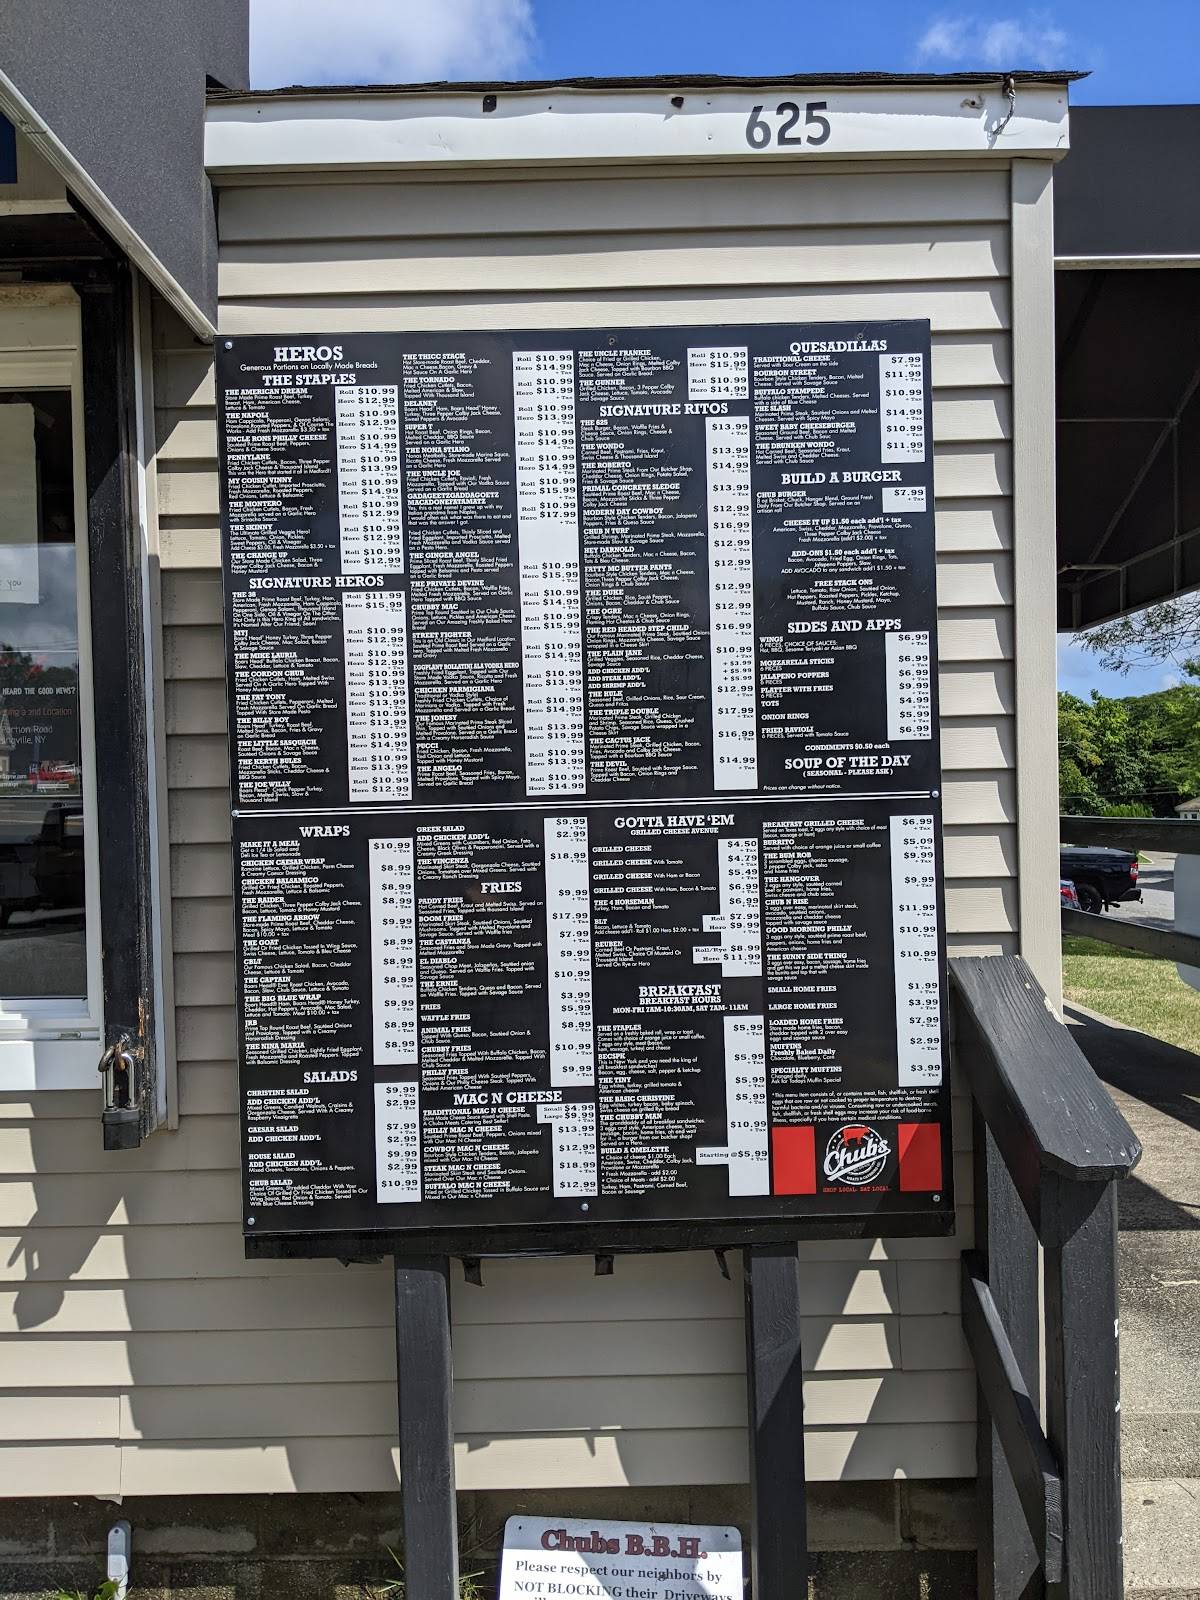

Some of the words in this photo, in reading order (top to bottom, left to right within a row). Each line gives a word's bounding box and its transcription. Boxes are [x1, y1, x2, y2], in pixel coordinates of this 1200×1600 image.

[746, 102, 830, 149] 625
[274, 346, 343, 362] HEROS
[790, 340, 887, 355] QUESADILLAS
[311, 362, 332, 370] Locally
[263, 374, 293, 386] THE
[296, 374, 356, 385] STAPLES
[600, 404, 681, 417] SIGNATURE
[684, 403, 728, 414] RITOS
[781, 473, 825, 485] BUILD
[829, 472, 839, 483] A
[843, 471, 902, 482] BURGER
[250, 577, 331, 589] SIGNATURE
[334, 576, 384, 588] HEROS
[787, 622, 827, 634] SIDES
[831, 620, 862, 631] AND
[866, 619, 902, 631] APPS
[38, 687, 53, 695] GOOD
[718, 707, 754, 715] $17.99
[899, 711, 929, 719] $5.99
[785, 758, 823, 770] SOUP
[826, 757, 846, 769] OF
[849, 756, 878, 768] THE
[882, 755, 911, 767] DAY
[615, 817, 664, 829] GOTTA
[667, 816, 705, 827] HAVE
[299, 826, 350, 837] WRAPS
[481, 882, 522, 894] FRIES
[639, 985, 721, 997] BREAKFAST
[908, 982, 938, 990] $1.99
[639, 997, 690, 1005] BREAKFAST
[303, 1071, 358, 1083] SALADS
[454, 1093, 488, 1105] MAC
[492, 1093, 503, 1104] N
[506, 1091, 562, 1103] CHEESE
[824, 1138, 889, 1176] Chubs
[541, 1529, 620, 1554] Chubs
[625, 1534, 708, 1559] B.B.H.
[515, 1560, 557, 1573] Please
[560, 1563, 607, 1576] respect
[611, 1567, 635, 1578] our
[638, 1568, 703, 1581] neighbors
[707, 1572, 722, 1584] by
[514, 1581, 544, 1593] NOT
[547, 1582, 622, 1597] BLOCKING
[626, 1586, 658, 1600] their
[664, 1590, 732, 1600] Driveways
